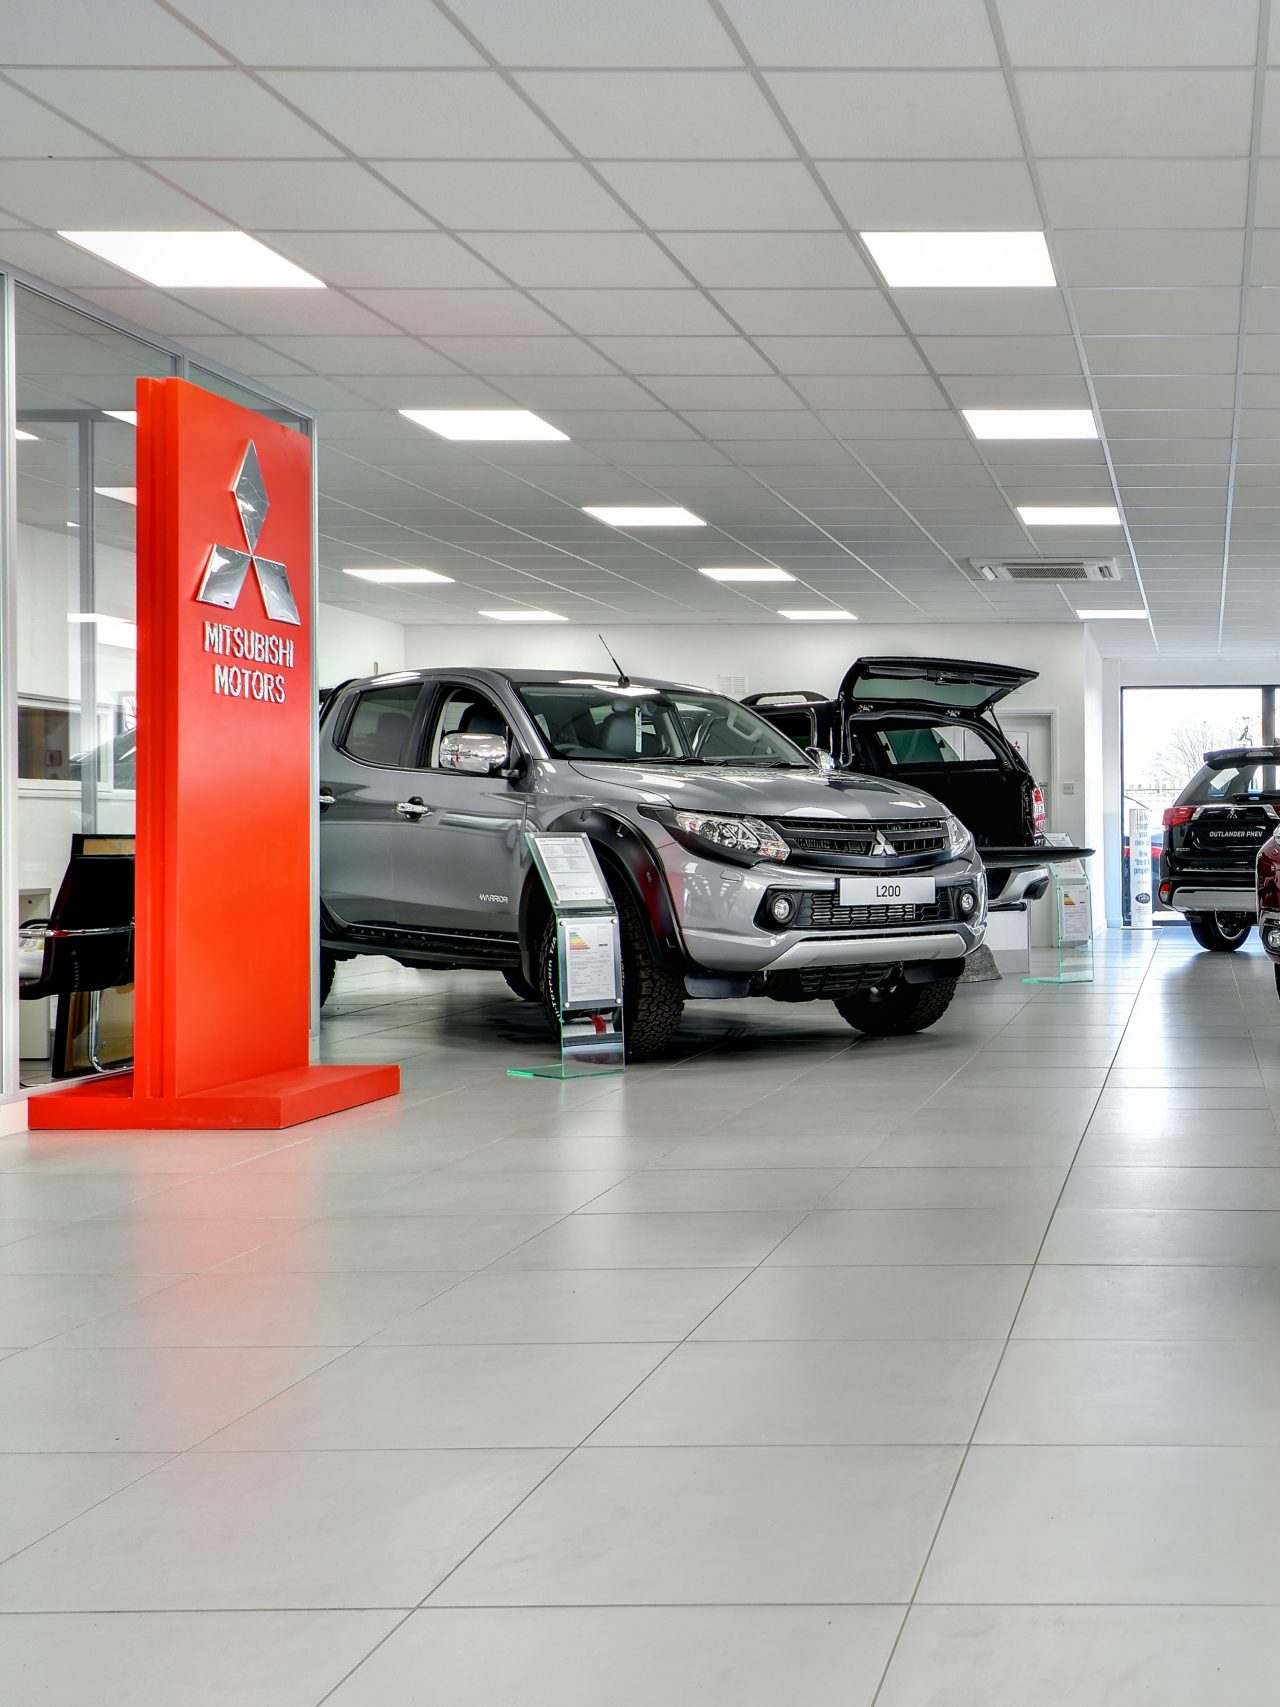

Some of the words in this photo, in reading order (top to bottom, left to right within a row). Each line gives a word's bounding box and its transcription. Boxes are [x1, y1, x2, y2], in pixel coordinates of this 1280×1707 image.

[204, 620, 294, 668] MITSUBISHI
[214, 663, 286, 704] MOTORS
[1209, 830, 1245, 838] OUTLANDER
[1246, 830, 1263, 838] PHEV
[876, 885, 901, 898] L200
[479, 893, 509, 904] WARRIOR
